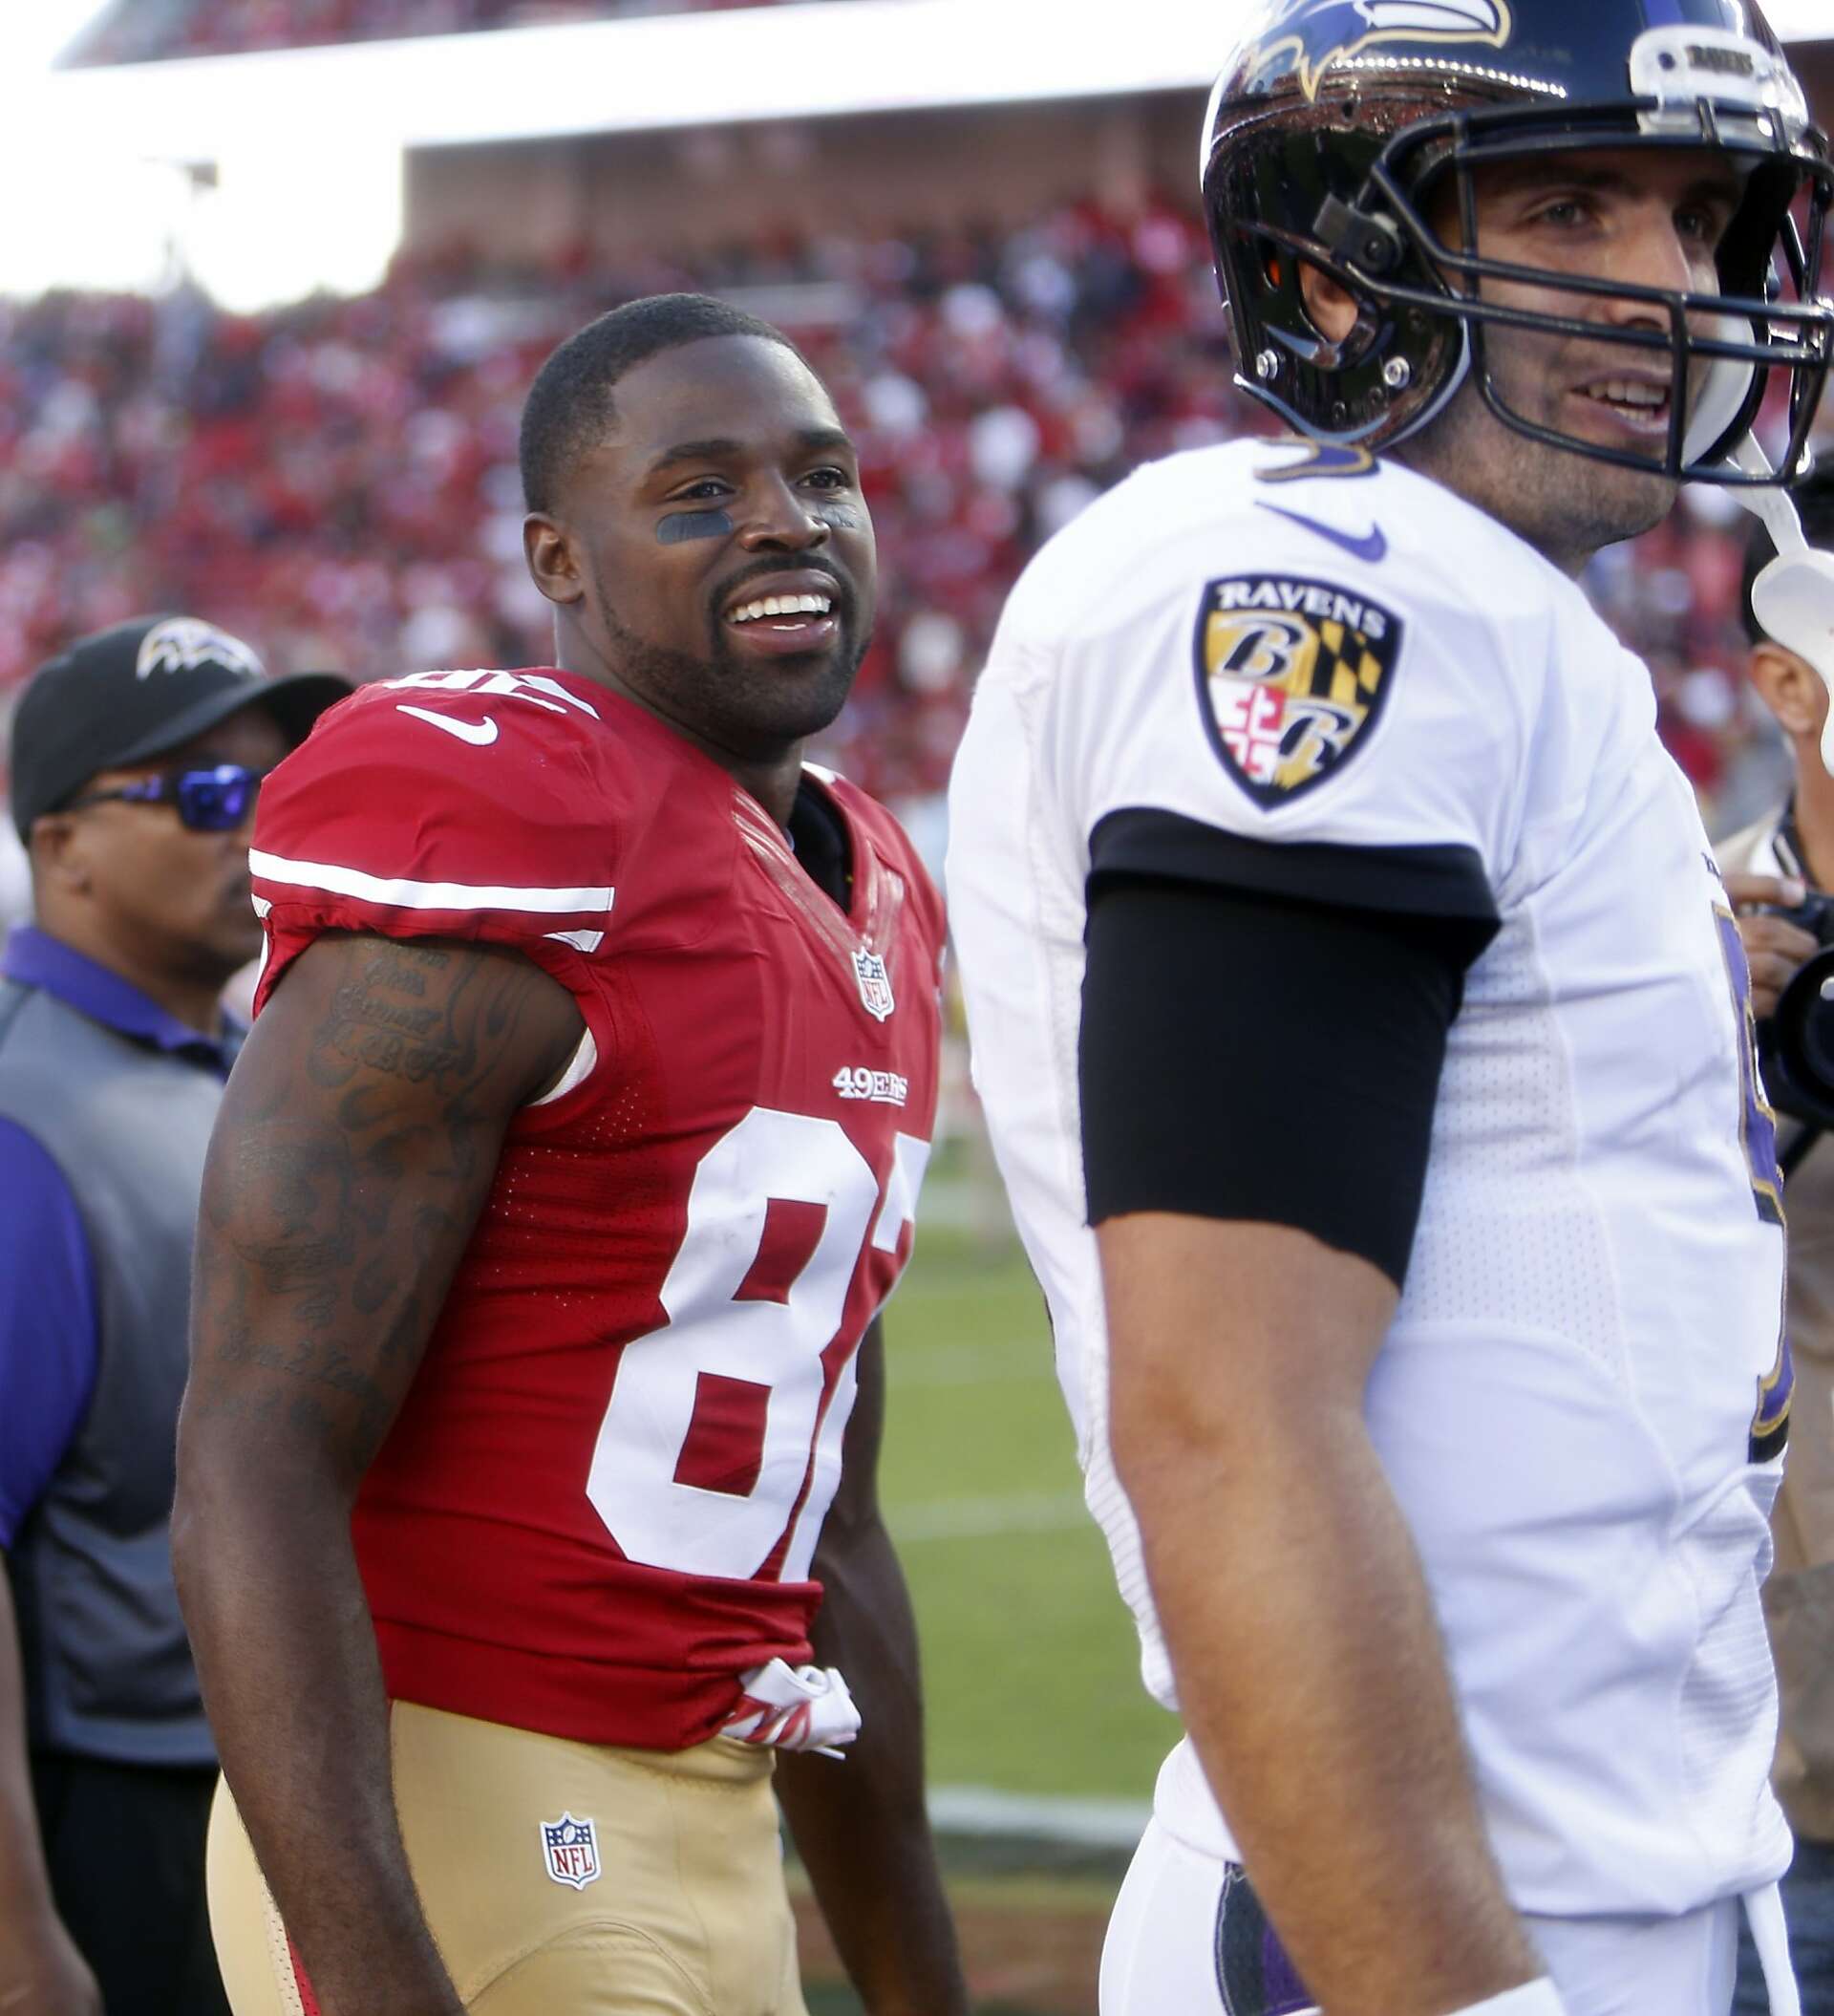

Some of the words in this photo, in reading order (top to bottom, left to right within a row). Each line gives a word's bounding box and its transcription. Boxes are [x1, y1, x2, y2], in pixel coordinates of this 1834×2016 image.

[1216, 580, 1385, 639] RAVENS
[863, 980, 889, 1006] NFL
[832, 1067, 908, 1105] 49ERS
[553, 1847, 593, 1877] NFL
